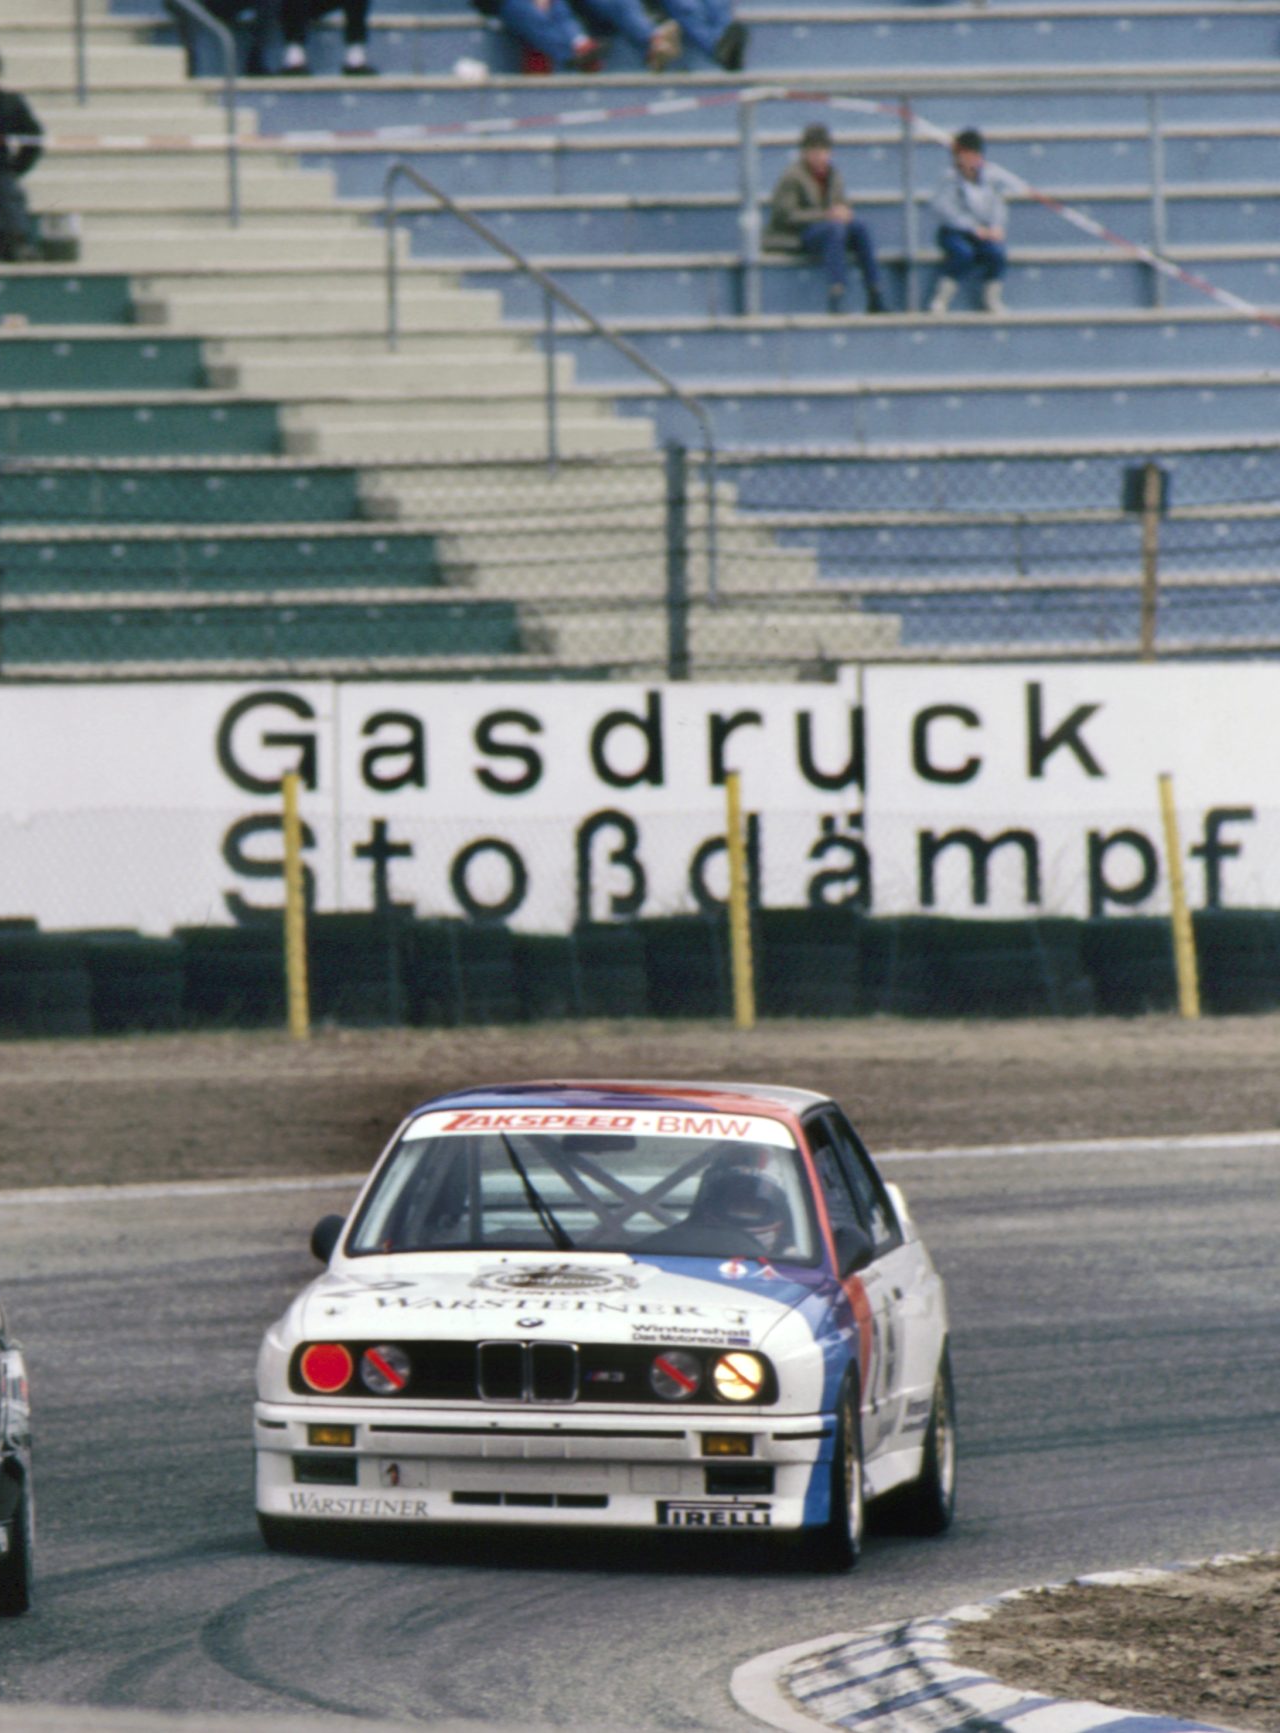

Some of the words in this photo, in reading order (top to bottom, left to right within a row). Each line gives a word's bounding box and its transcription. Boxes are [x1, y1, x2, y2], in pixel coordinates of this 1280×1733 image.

[216, 682, 1107, 795] Gasdruck
[441, 1113, 636, 1132] ZAKSPEED
[657, 1115, 751, 1137] BMW
[375, 1296, 707, 1317] WARSTEINER
[288, 1491, 430, 1517] WARSTEINER
[656, 1500, 773, 1526] PIRELLI
